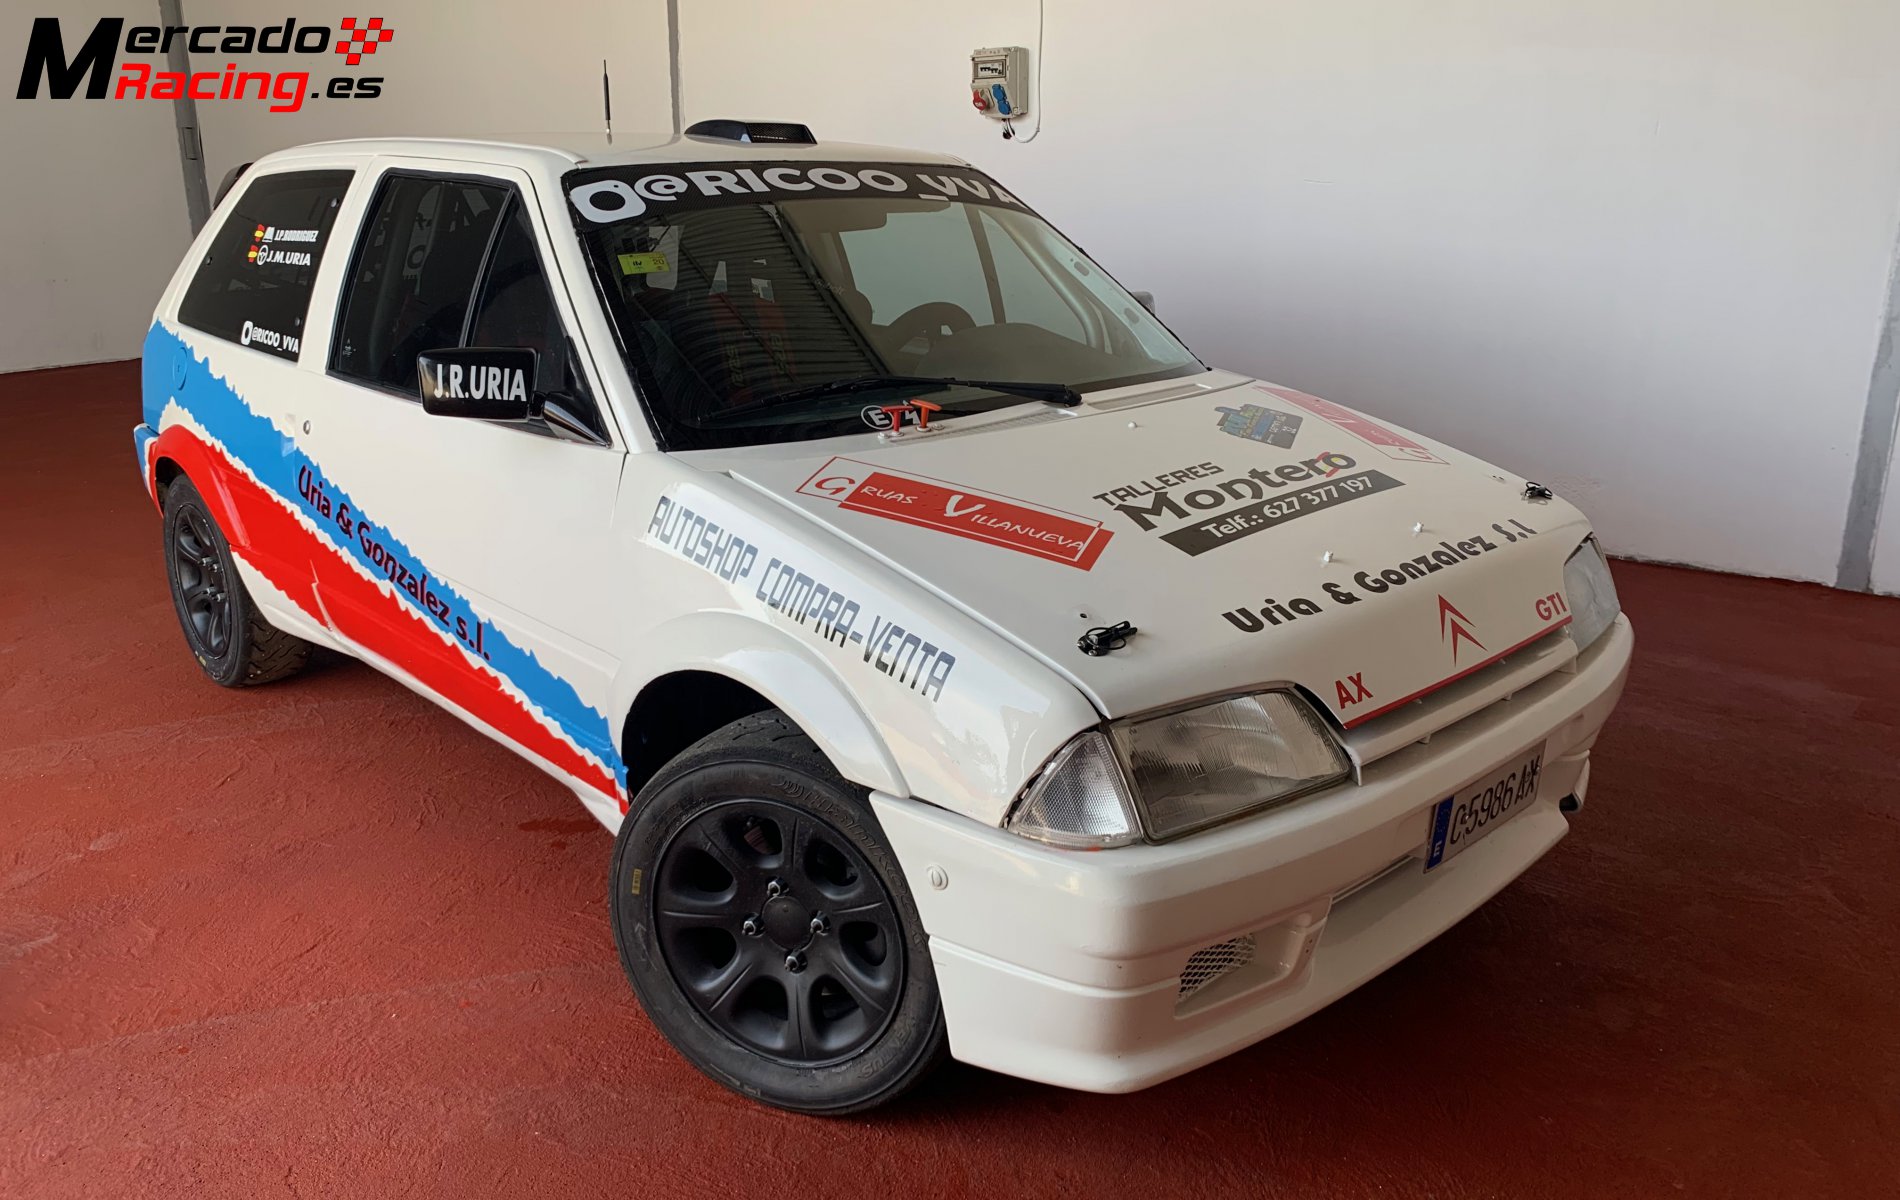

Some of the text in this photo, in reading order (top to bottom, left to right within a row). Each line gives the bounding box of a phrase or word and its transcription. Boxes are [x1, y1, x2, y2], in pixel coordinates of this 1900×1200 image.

[266, 250, 311, 266] J.M.URIA
[433, 363, 527, 402] J.R.URIA
[1092, 461, 1225, 507] TALLERES
[1113, 451, 1357, 532] Montero
[1262, 499, 1301, 519] 627
[1300, 484, 1339, 506] 377
[1339, 475, 1374, 494] 197
[298, 464, 332, 519] Uria
[336, 502, 353, 539] &
[357, 521, 451, 627] Gonzalez
[647, 495, 759, 585] AUTOSHOP
[944, 494, 1086, 551] VILLANUEVA
[1221, 598, 1323, 634] Uria
[1321, 581, 1363, 606] &
[1353, 534, 1499, 594] Gonzalez
[1535, 591, 1568, 622] GTI
[1335, 671, 1374, 710] AX
